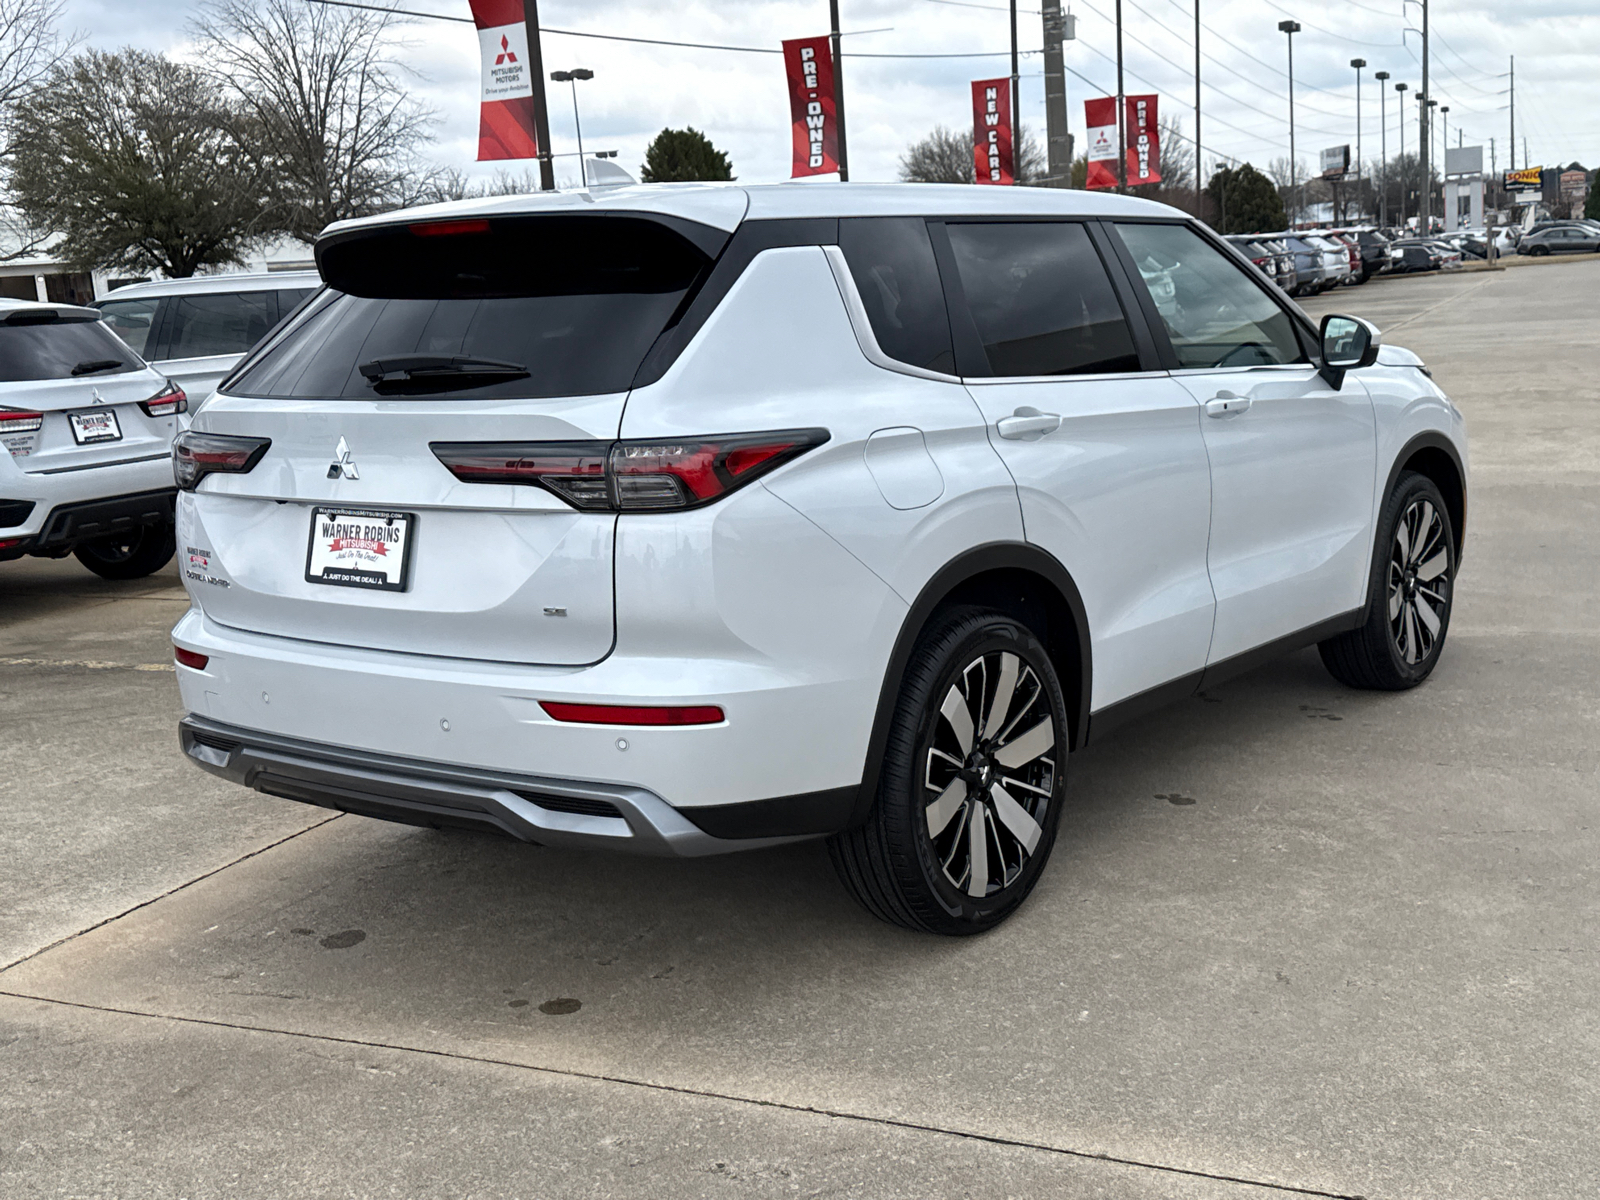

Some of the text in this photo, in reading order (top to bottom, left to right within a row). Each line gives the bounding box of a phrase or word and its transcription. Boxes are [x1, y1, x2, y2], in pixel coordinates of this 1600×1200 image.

[491, 65, 523, 77] MITSUBISHI
[495, 74, 520, 84] MOTORS
[800, 47, 825, 168] PRE-OWNED
[985, 86, 1001, 181] NEW CARS
[1136, 100, 1150, 179] PRE-OWNED
[1507, 170, 1540, 181] SONIC
[322, 522, 400, 543] WARNER ROBINS
[339, 539, 379, 551] MITSUBISHI
[335, 551, 347, 560] Just
[347, 550, 355, 558] Do
[355, 550, 364, 559] The
[361, 576, 378, 584] DEAL!
